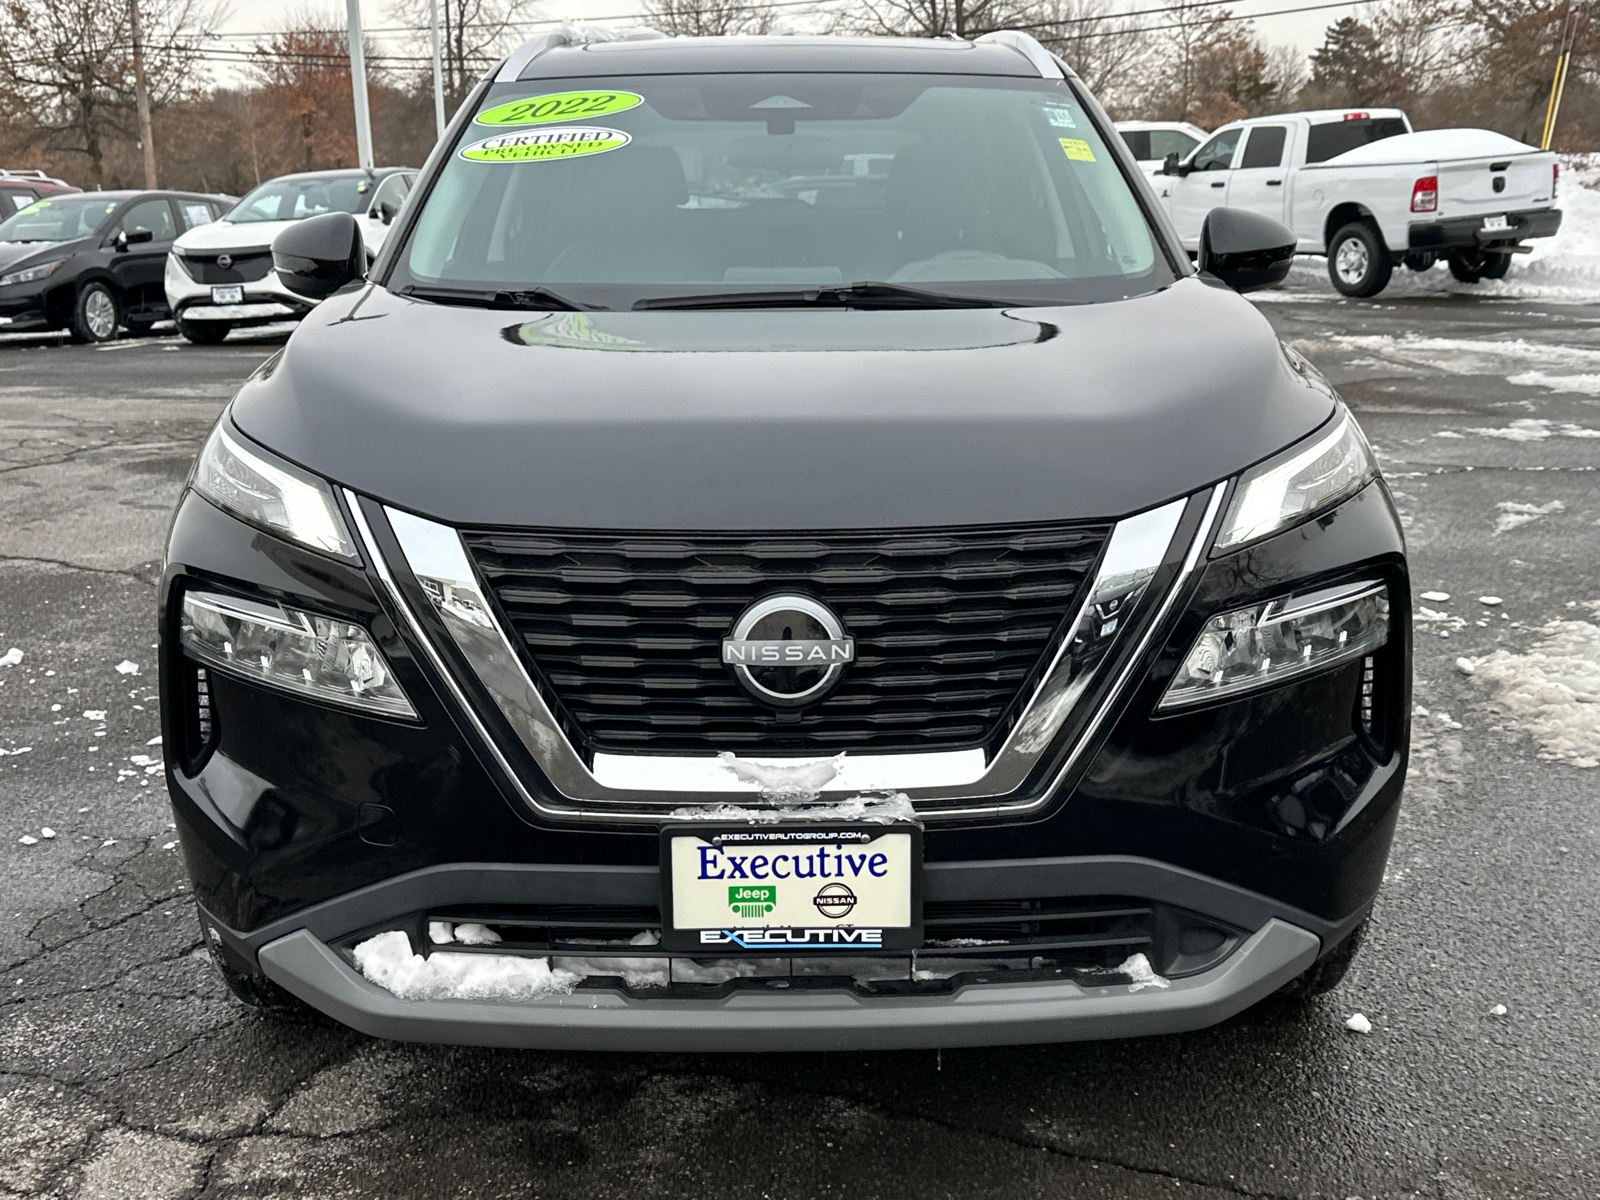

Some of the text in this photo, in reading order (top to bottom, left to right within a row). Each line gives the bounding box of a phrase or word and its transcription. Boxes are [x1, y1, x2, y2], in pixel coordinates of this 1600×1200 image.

[500, 95, 617, 123] 2022
[481, 131, 613, 150] CERTIFIED
[726, 643, 850, 661] NISSAN
[720, 832, 862, 841] EXECUTIVEAUTOGROUP.COM
[697, 843, 888, 880] Executive
[735, 888, 770, 901] Jeep
[816, 896, 855, 905] NISSAN
[700, 929, 882, 945] EXECUTIVE
